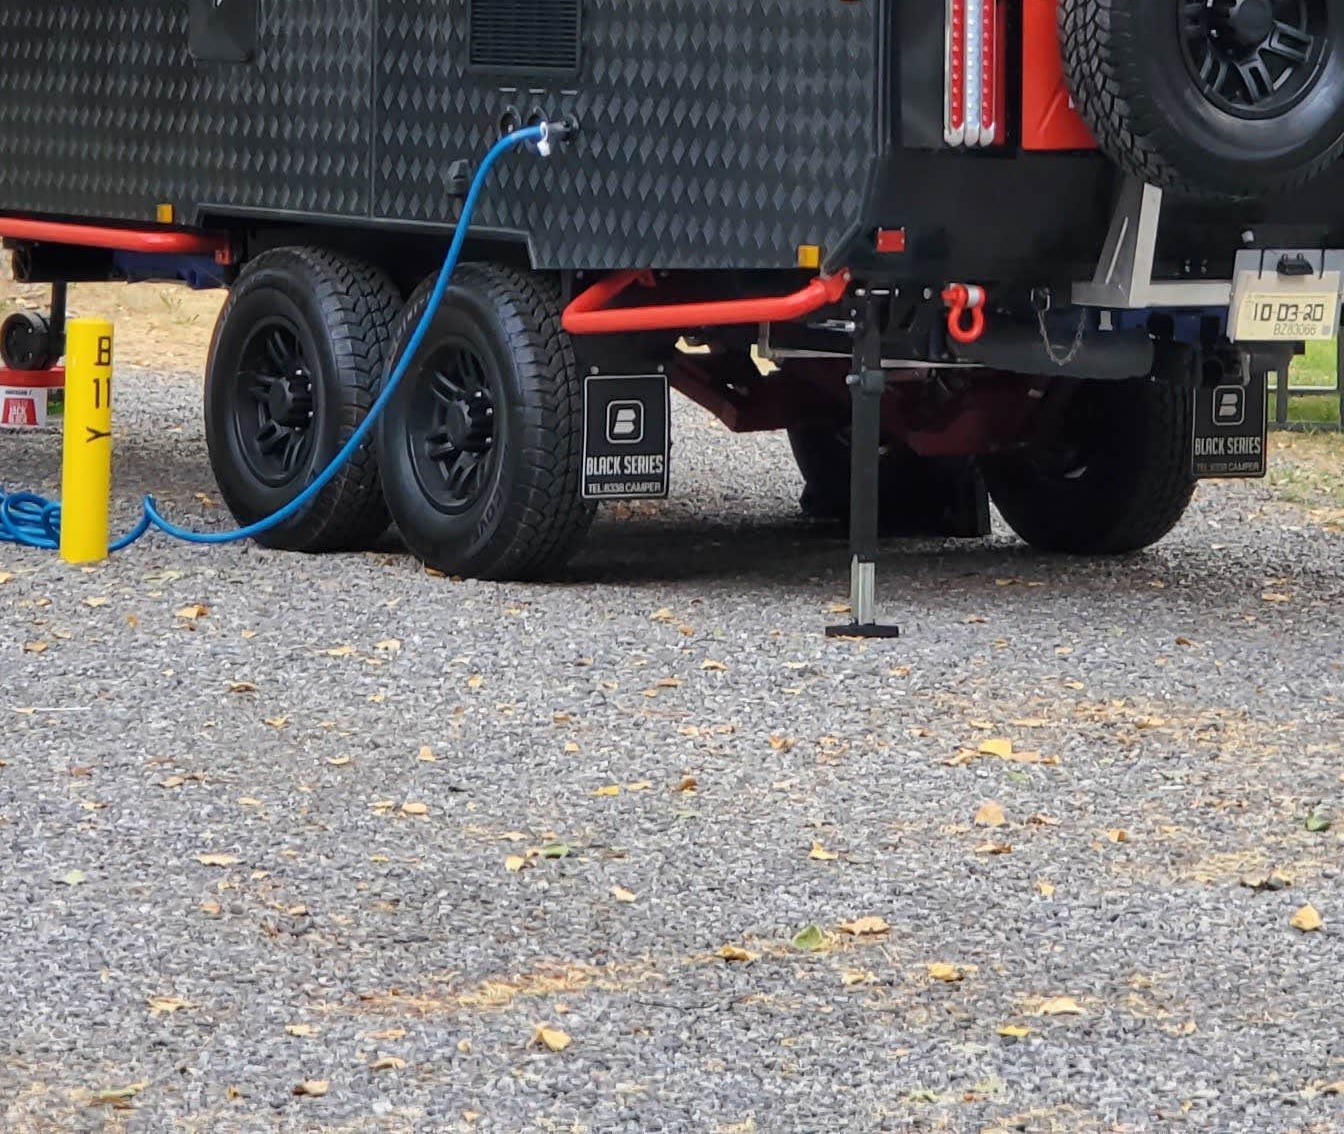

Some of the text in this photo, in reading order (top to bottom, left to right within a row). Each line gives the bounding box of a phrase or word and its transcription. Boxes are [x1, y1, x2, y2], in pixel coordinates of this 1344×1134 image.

[1194, 437, 1261, 455] BLACK SERIES
[586, 455, 663, 476] BLACK SERIES
